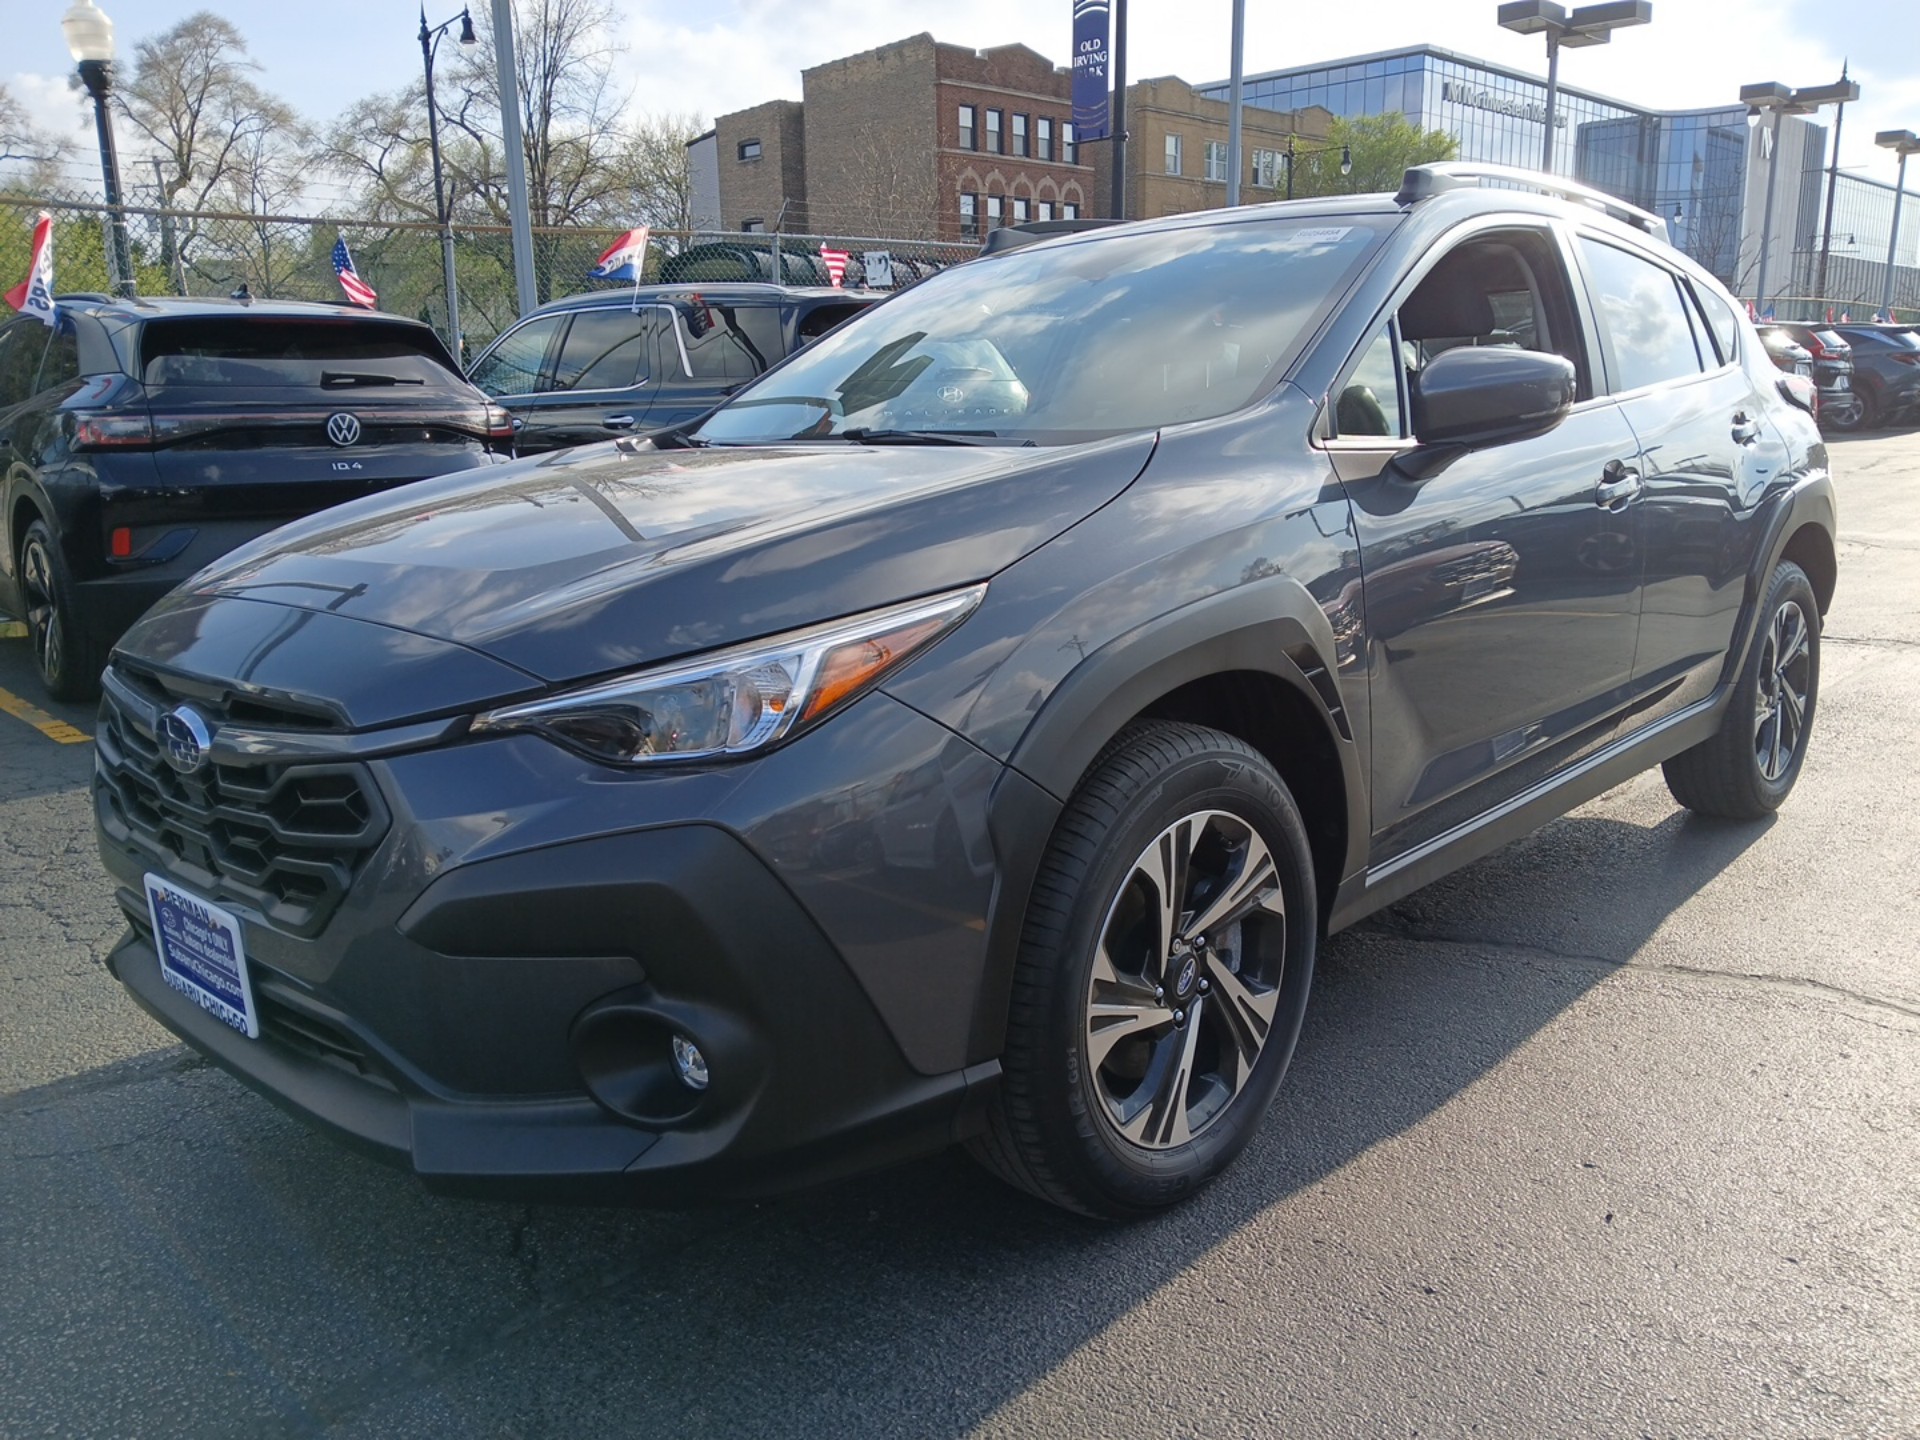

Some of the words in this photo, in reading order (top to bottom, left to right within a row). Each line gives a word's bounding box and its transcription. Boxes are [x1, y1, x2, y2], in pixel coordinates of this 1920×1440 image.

[1073, 51, 1108, 67] IRVING
[1080, 38, 1101, 52] OLD
[1462, 83, 1530, 118] Northwestern
[167, 943, 245, 998] SubaruChicago.com
[163, 968, 201, 1003] SUBARU
[201, 993, 248, 1034] CHICAGO
